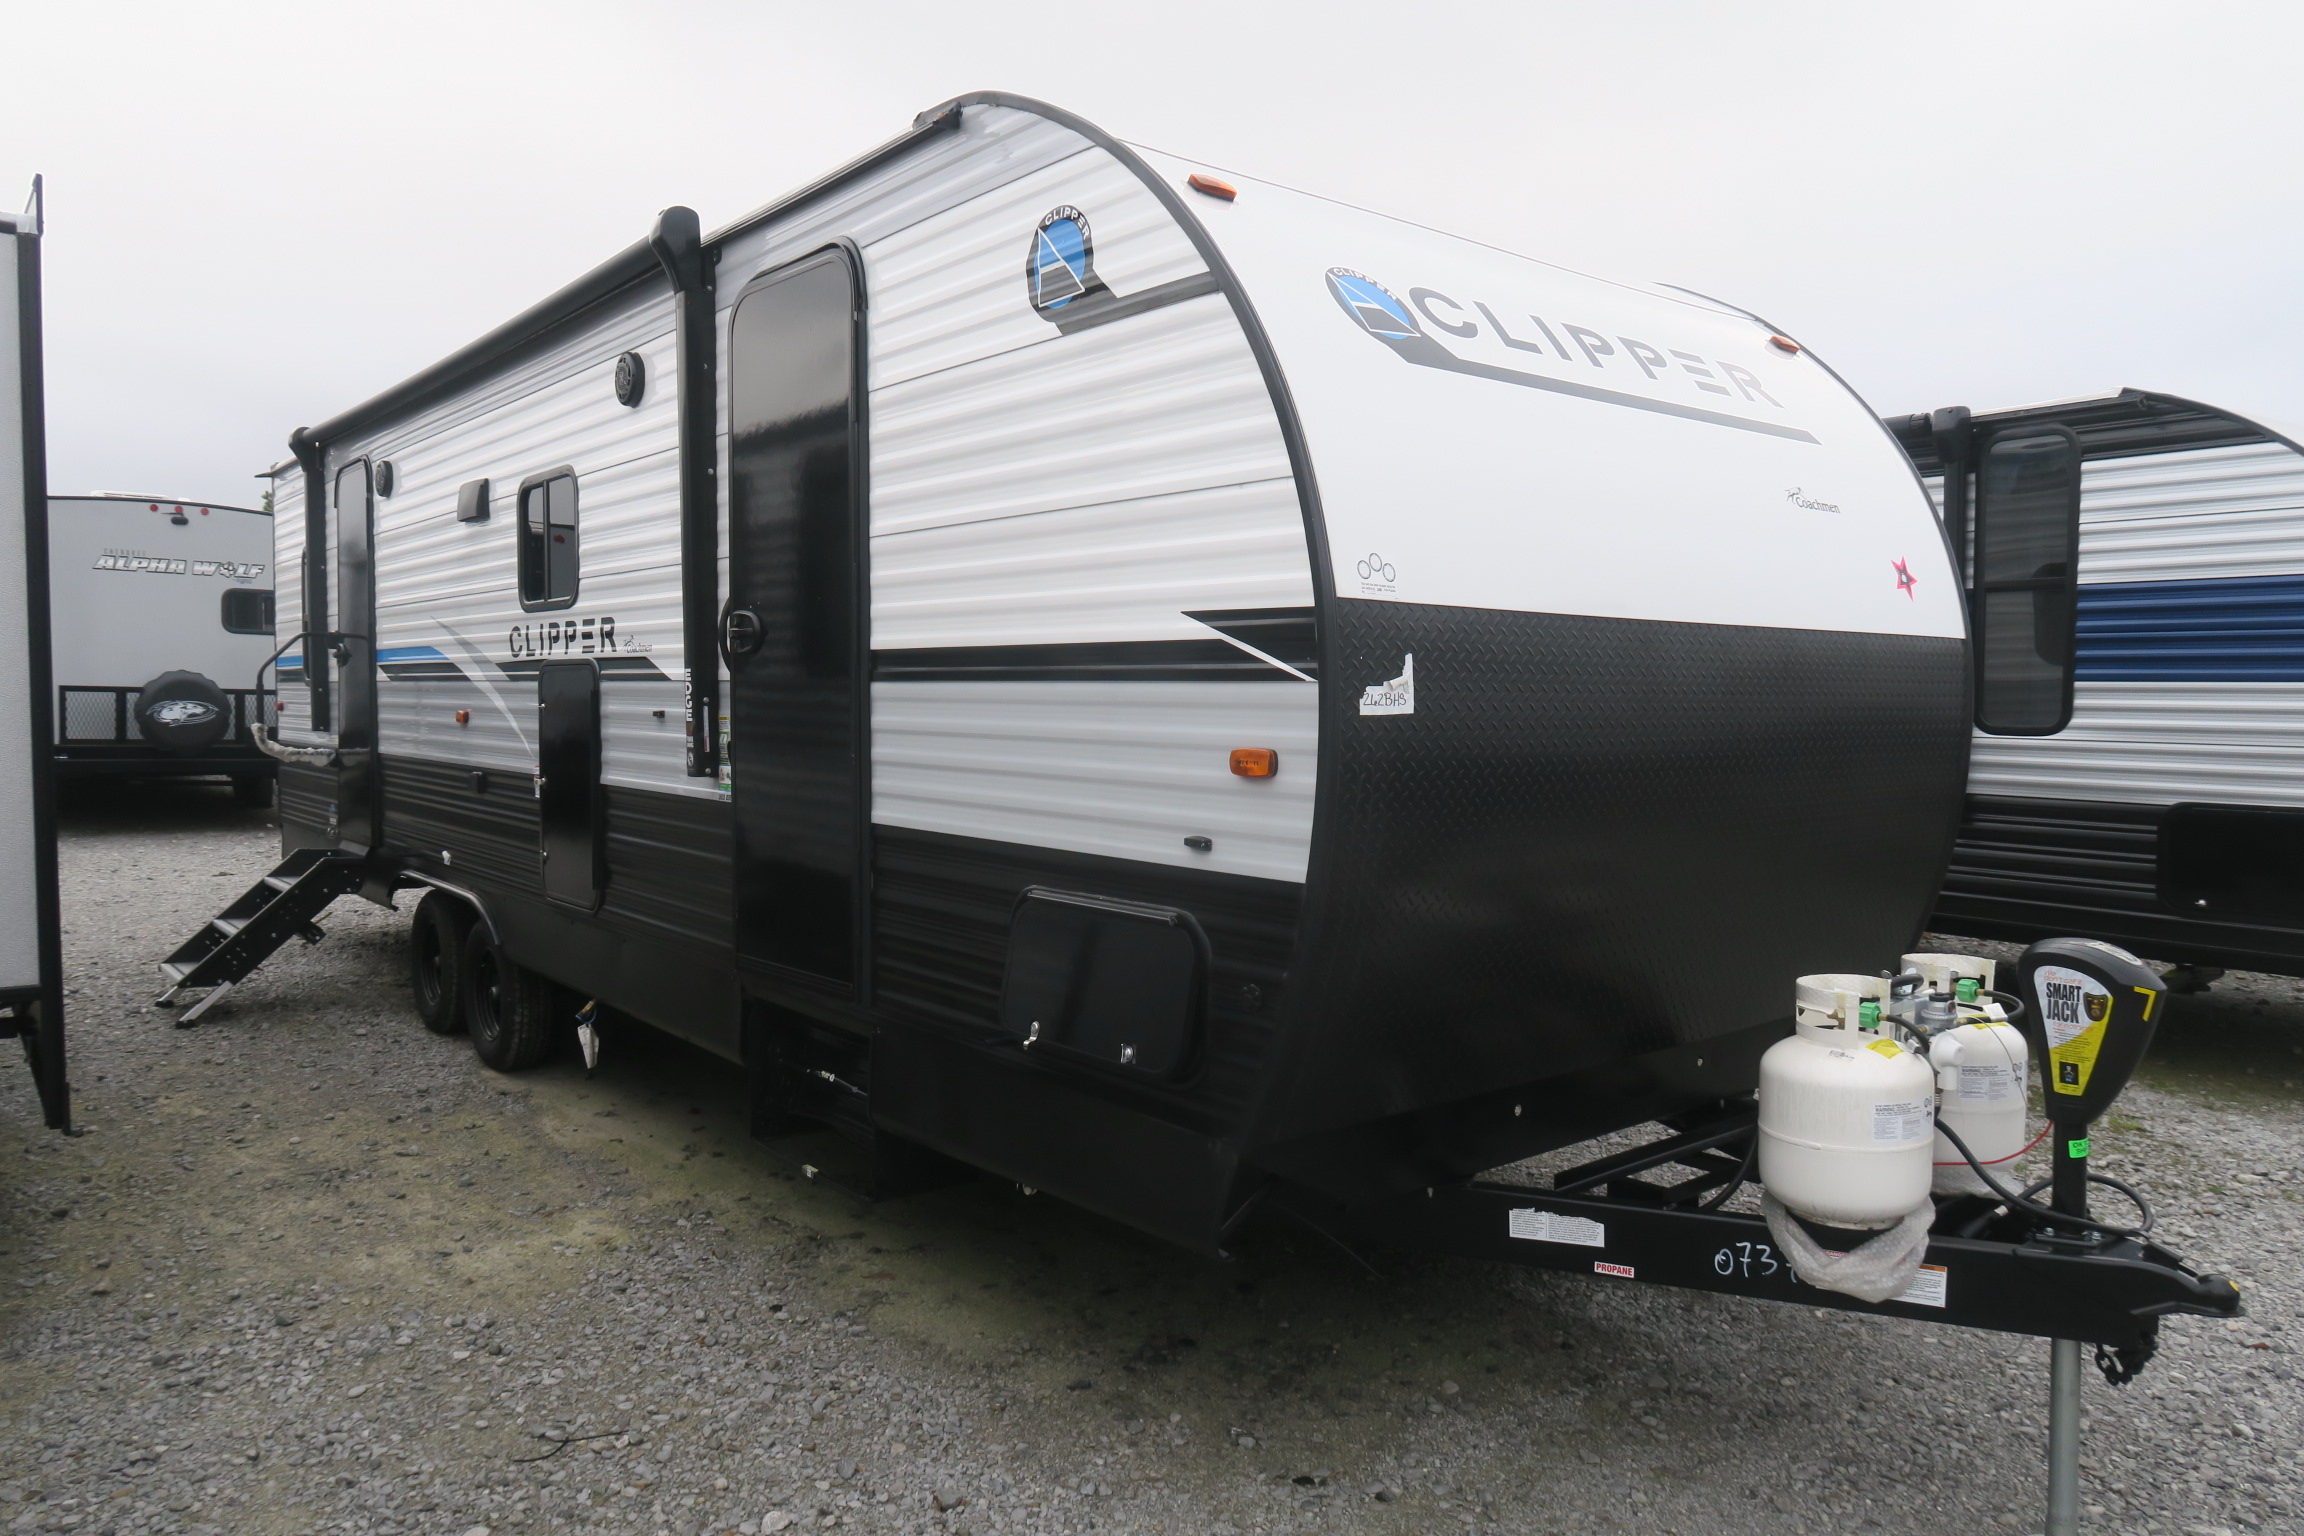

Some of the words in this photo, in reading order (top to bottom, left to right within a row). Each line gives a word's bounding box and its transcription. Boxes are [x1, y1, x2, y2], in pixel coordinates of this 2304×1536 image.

[1045, 207, 1091, 241] CLIPPER
[1333, 268, 1398, 301] CLIPPER
[1407, 286, 1786, 409] CLIPPER
[1795, 496, 1841, 514] Coachmen
[92, 554, 187, 575] ALPHA
[509, 616, 618, 659] CLIPPER
[684, 668, 693, 722] EDGE
[2046, 982, 2082, 1003] SMART
[2046, 999, 2080, 1024] JACK
[1595, 1262, 1633, 1276] PROPANE
